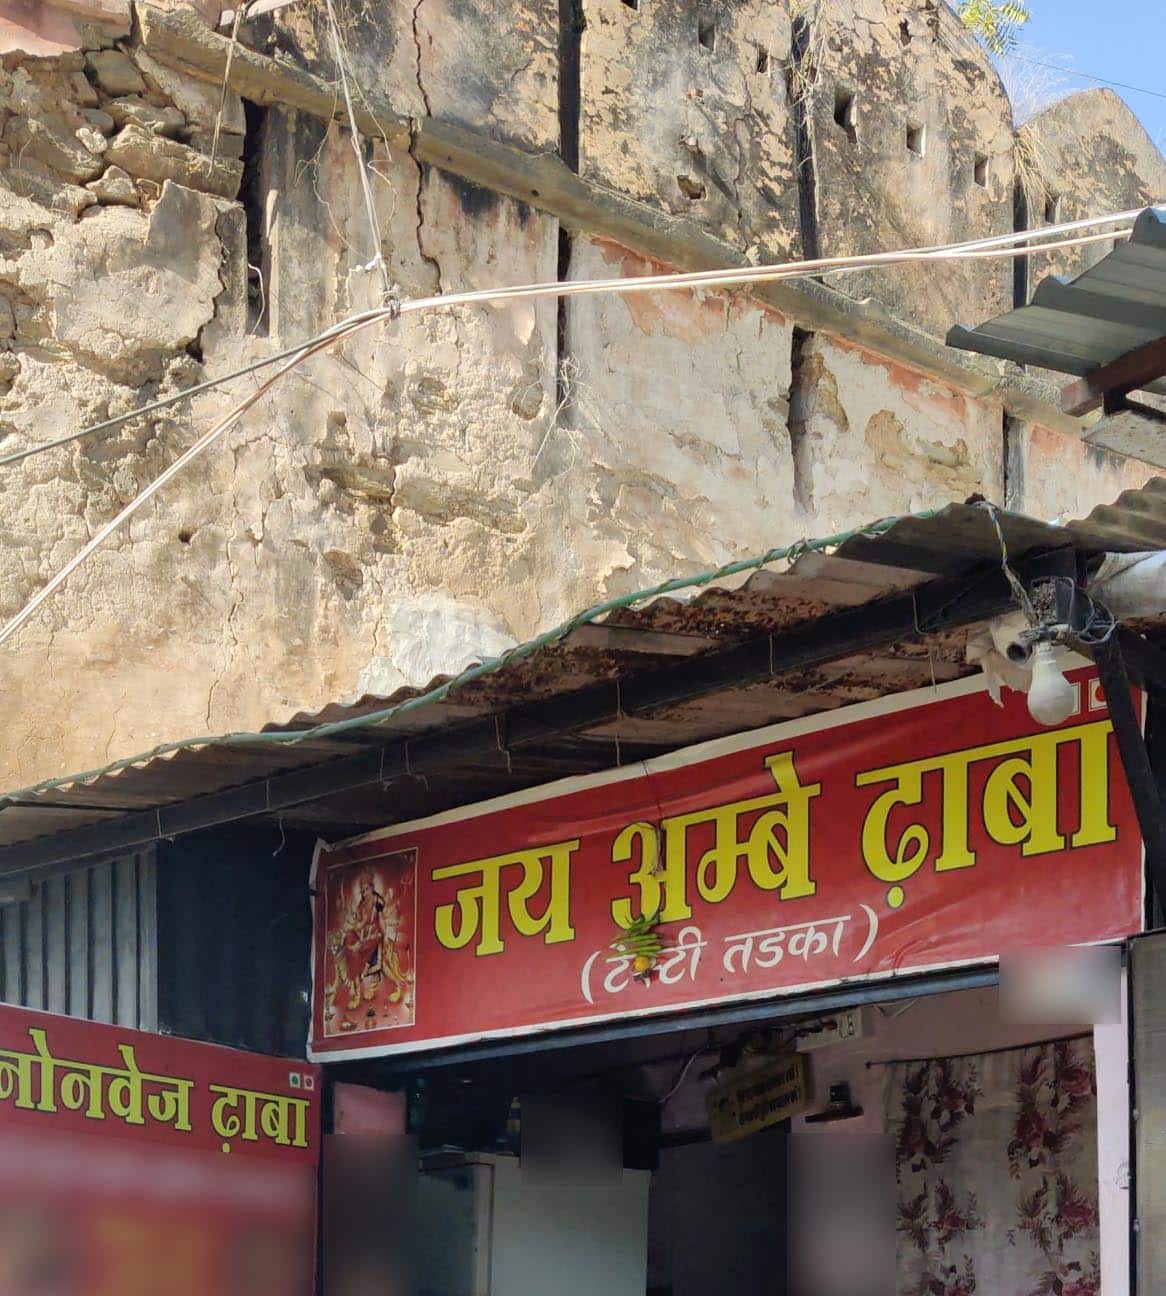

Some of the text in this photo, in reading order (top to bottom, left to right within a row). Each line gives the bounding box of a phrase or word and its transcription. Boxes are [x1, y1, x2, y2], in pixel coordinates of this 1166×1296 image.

[431, 720, 1119, 956] जय अम्बे ढ़ाबा
[209, 1084, 311, 1154] ढ़ाबा
